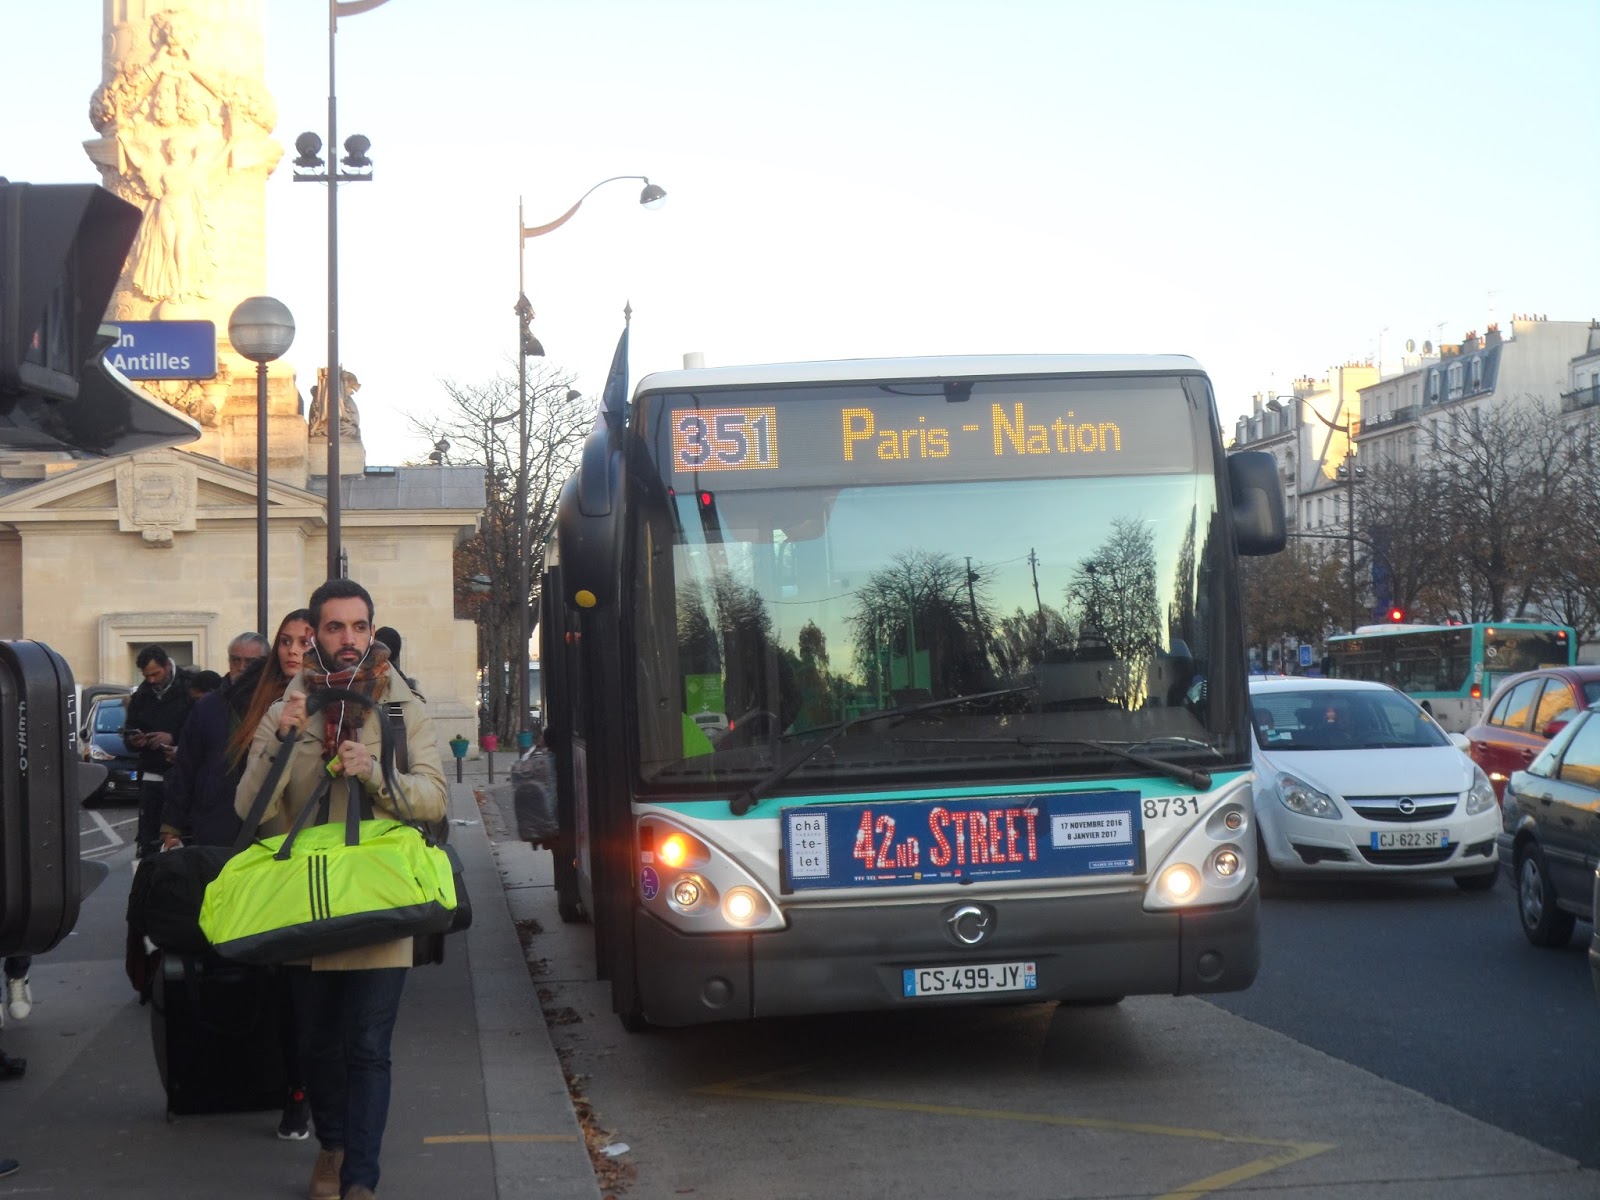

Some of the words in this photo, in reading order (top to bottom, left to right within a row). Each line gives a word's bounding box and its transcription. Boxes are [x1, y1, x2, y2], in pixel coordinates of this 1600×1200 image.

[113, 352, 190, 370] Antilles
[678, 412, 770, 467] 351
[842, 408, 950, 461] Paris
[992, 402, 1121, 456] Nation
[1143, 796, 1200, 819] 8731
[795, 819, 821, 831] châ
[1060, 822, 1068, 830] 17
[1069, 820, 1105, 829] NOVEMBRE
[1106, 819, 1123, 827] 2016
[928, 807, 1040, 867] STREET
[1073, 832, 1100, 840] JANVIER
[1101, 830, 1117, 838] 2017
[1380, 832, 1439, 847] CJ-622-SF
[799, 856, 820, 867] let
[920, 965, 1020, 992] CS-499-JY
[1025, 975, 1037, 987] 75
